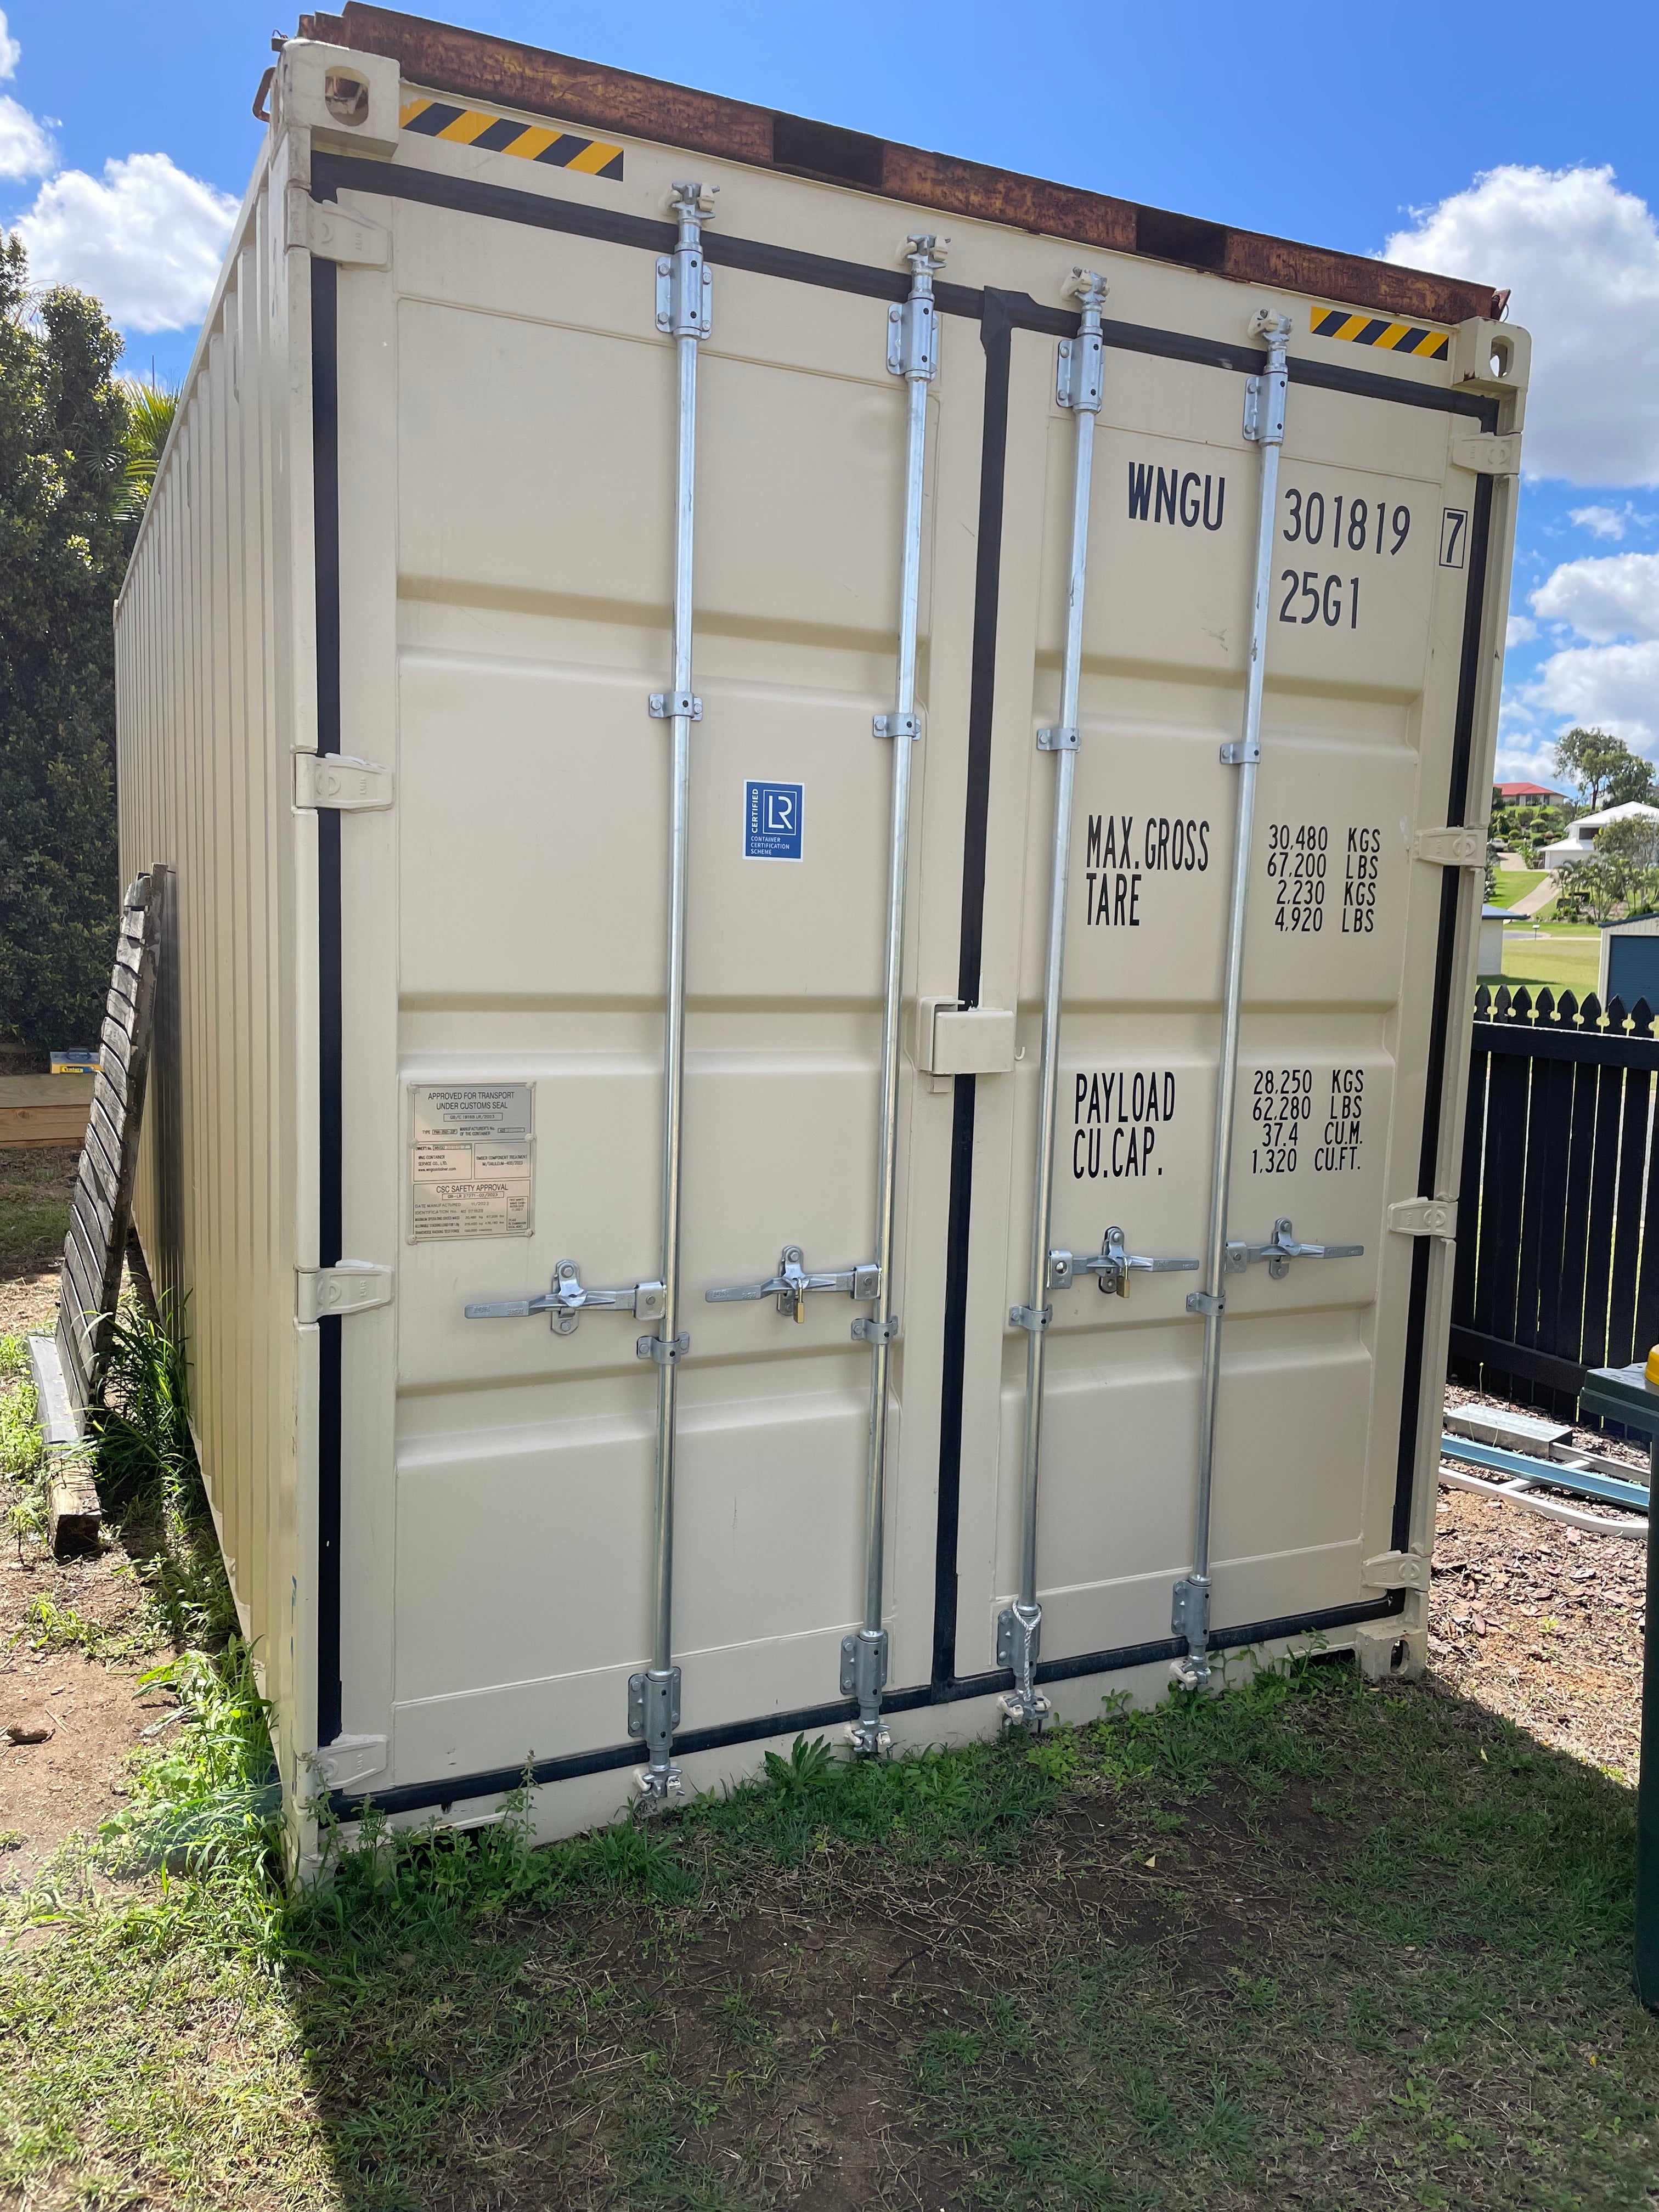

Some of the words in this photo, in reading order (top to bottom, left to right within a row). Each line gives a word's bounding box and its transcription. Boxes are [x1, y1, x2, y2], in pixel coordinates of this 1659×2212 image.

[1128, 461, 1225, 531] WNGU
[1283, 488, 1410, 556] 301819
[1445, 512, 1464, 564] 7
[1279, 569, 1359, 629] 25G1
[768, 795, 793, 830] LR
[1268, 824, 1328, 851] 30,480
[1347, 827, 1381, 853] KGS
[1267, 852, 1327, 878] 67,200
[1346, 854, 1379, 879] LBS
[1086, 873, 1142, 926] TARE
[1276, 879, 1325, 905] 2,230
[1344, 881, 1376, 906] KGS
[1274, 906, 1323, 932] 4,920
[1341, 907, 1374, 933] LBS
[1253, 1069, 1312, 1094] 28,250
[1331, 1069, 1364, 1094] KGS
[1075, 1071, 1175, 1125] PAYLOAD
[1252, 1096, 1311, 1121] 62,280
[1330, 1095, 1362, 1120] LBS
[1262, 1122, 1298, 1147] 37.4
[1324, 1120, 1363, 1145] CU.M.
[1073, 1126, 1163, 1180] CU.CAP.
[1252, 1148, 1297, 1174] 1,320
[1314, 1146, 1361, 1172] CU.FT.
